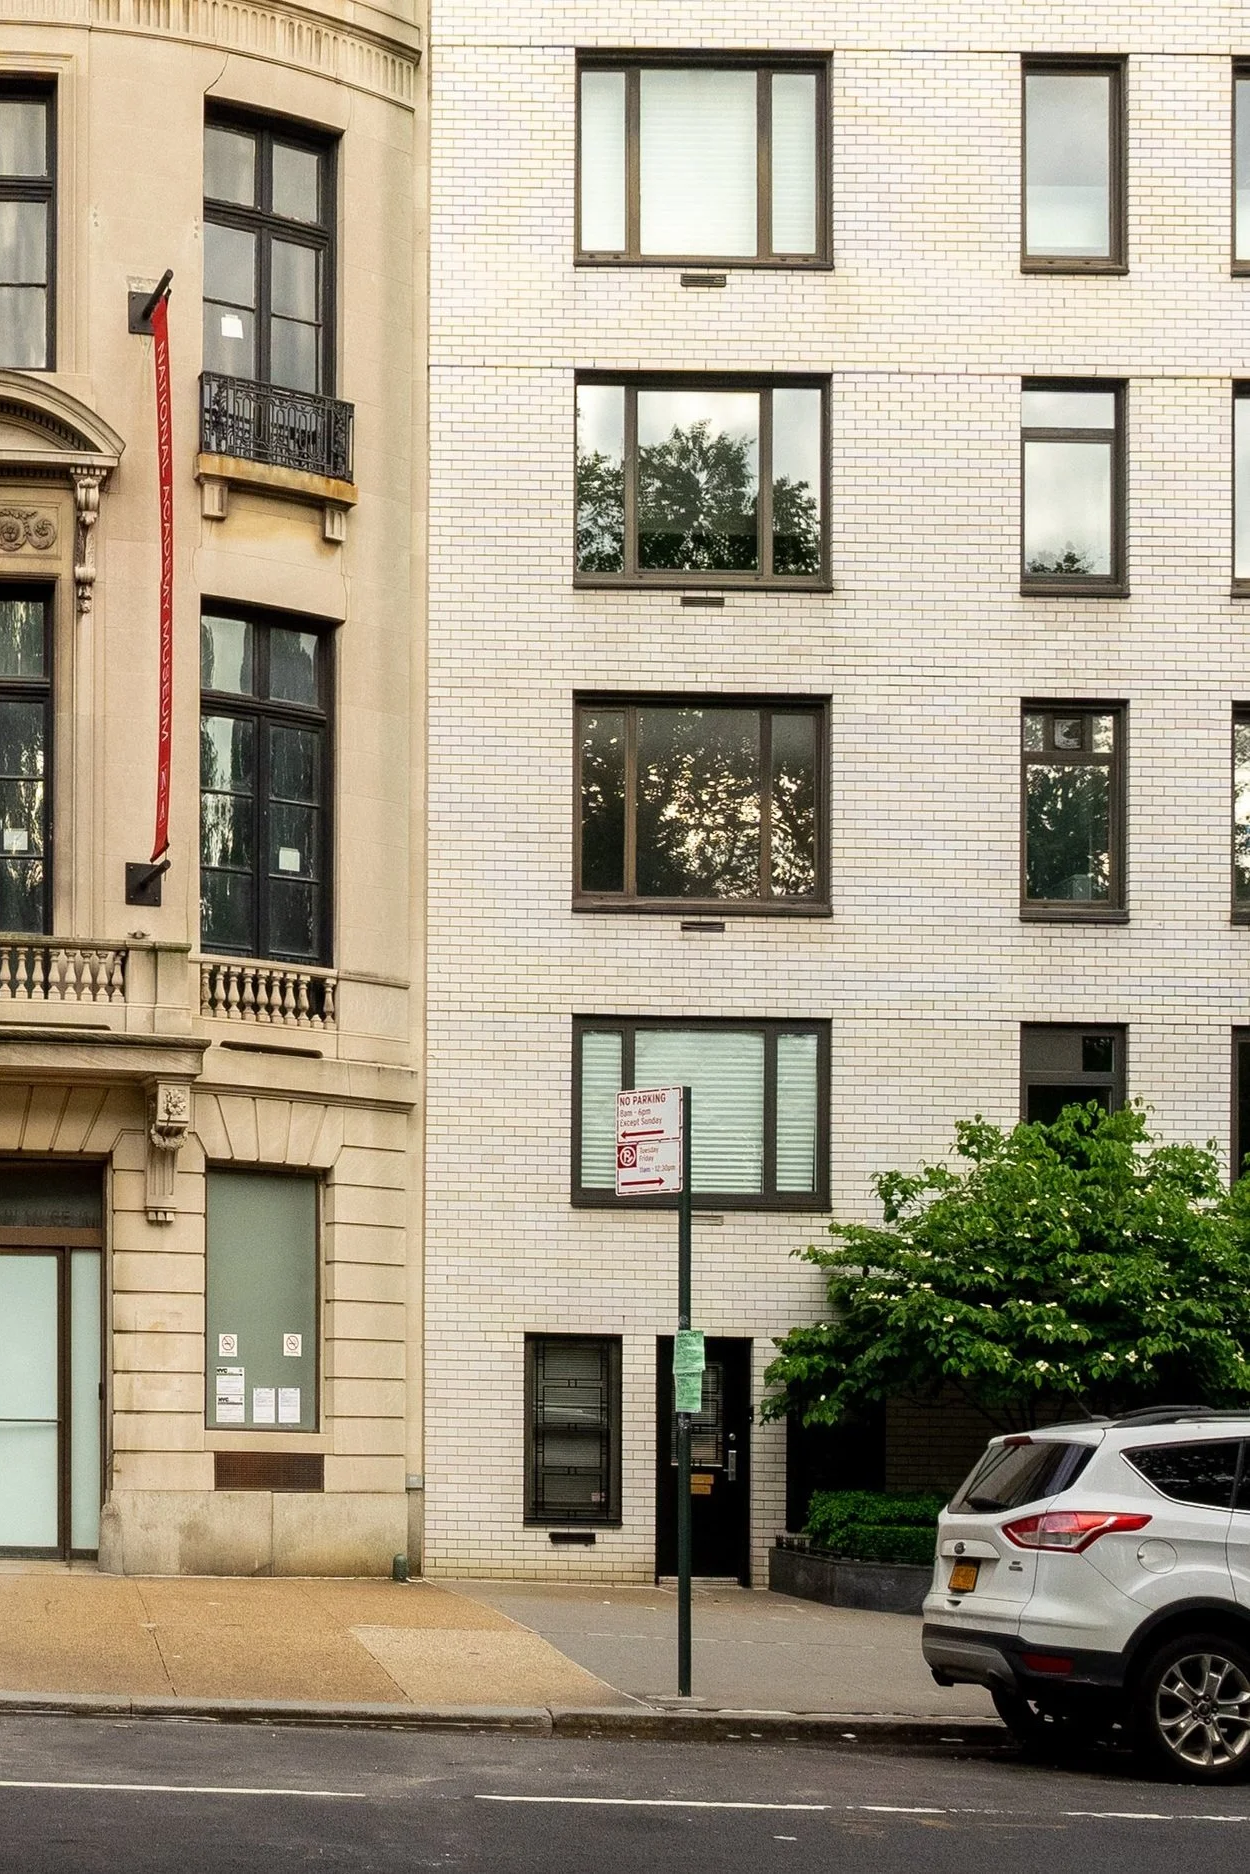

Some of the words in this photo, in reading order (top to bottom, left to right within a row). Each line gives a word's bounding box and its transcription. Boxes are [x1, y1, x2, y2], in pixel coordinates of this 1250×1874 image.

[157, 341, 169, 477] NATIONAL
[162, 486, 172, 608] ACADEMY
[160, 620, 171, 742] MUSEUM
[619, 1097, 631, 1106] NO
[632, 1093, 666, 1105] PARKING
[620, 1118, 639, 1127] Except
[641, 1117, 662, 1126] Sunday
[639, 1146, 659, 1155] Tuesday
[639, 1155, 654, 1163] Friday
